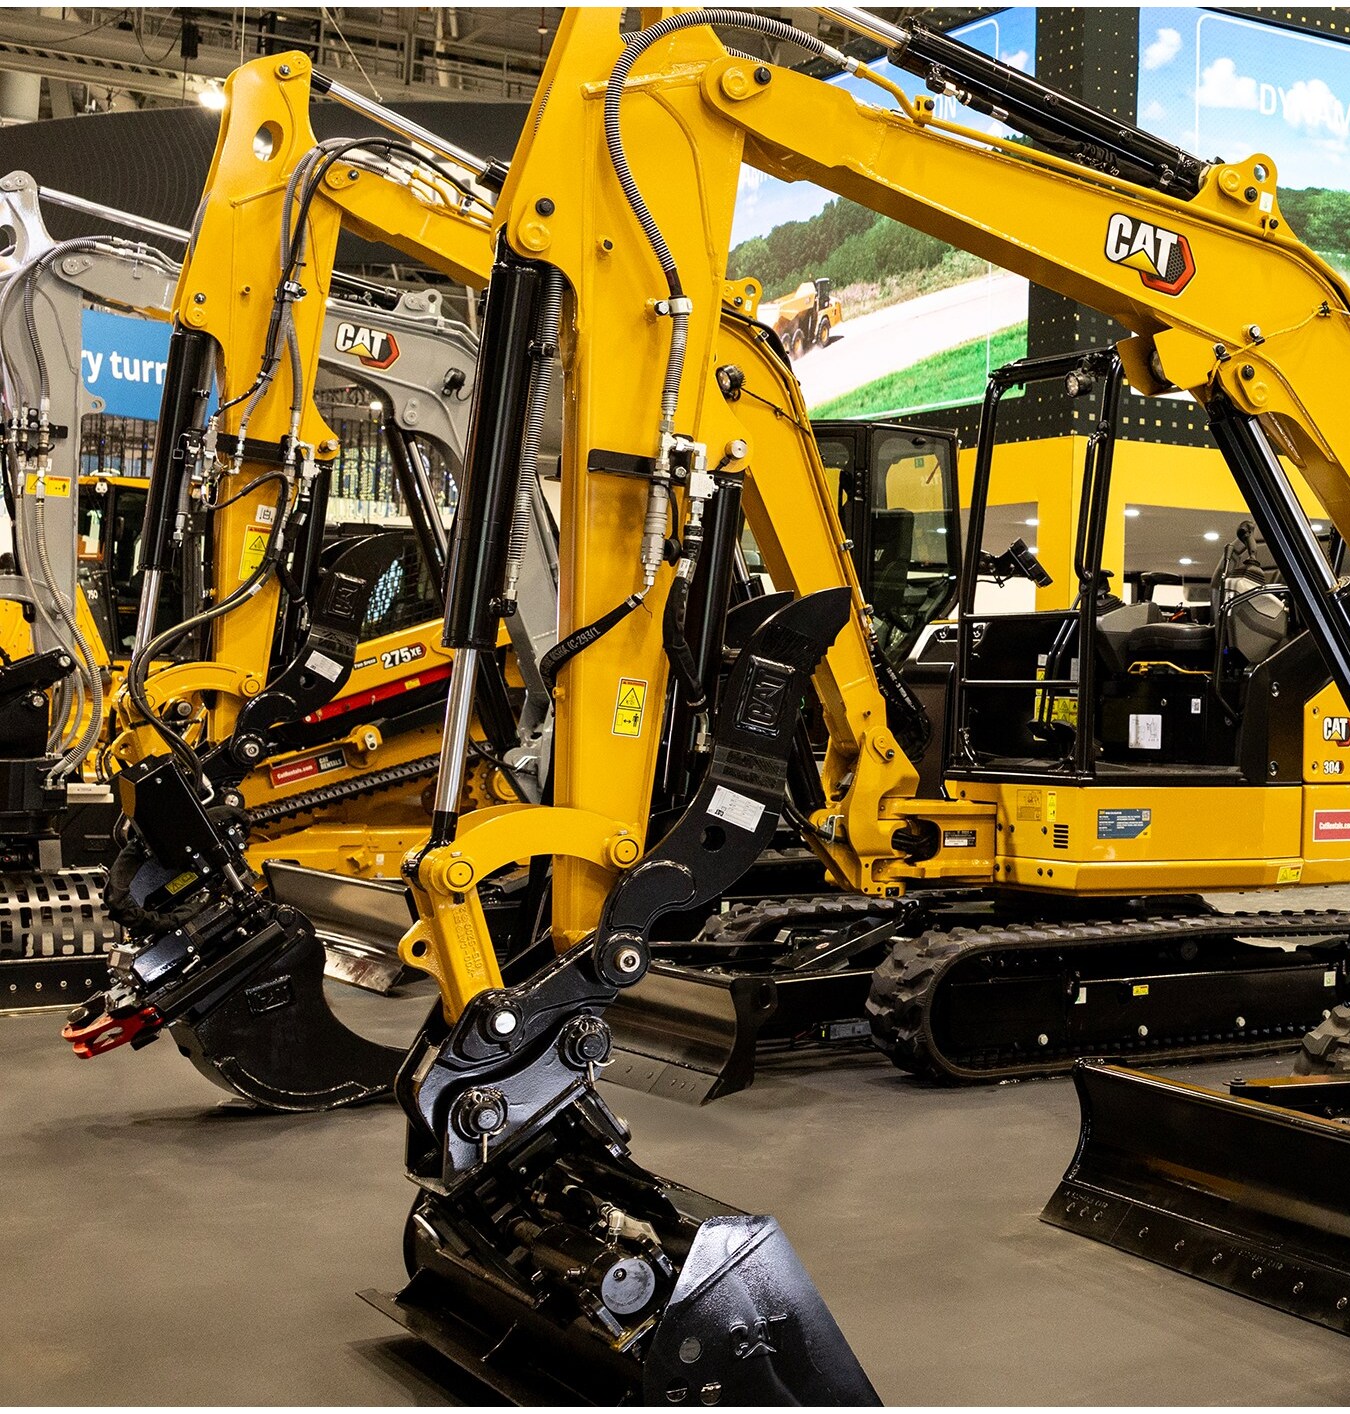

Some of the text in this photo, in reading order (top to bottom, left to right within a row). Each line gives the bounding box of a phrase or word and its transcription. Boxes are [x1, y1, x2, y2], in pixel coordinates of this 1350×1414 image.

[1105, 213, 1179, 278] CAT
[335, 322, 388, 360] CAT
[381, 646, 423, 669] 275XE
[747, 668, 787, 727] CAT
[1323, 717, 1348, 740] CAT
[1323, 761, 1340, 774] 304
